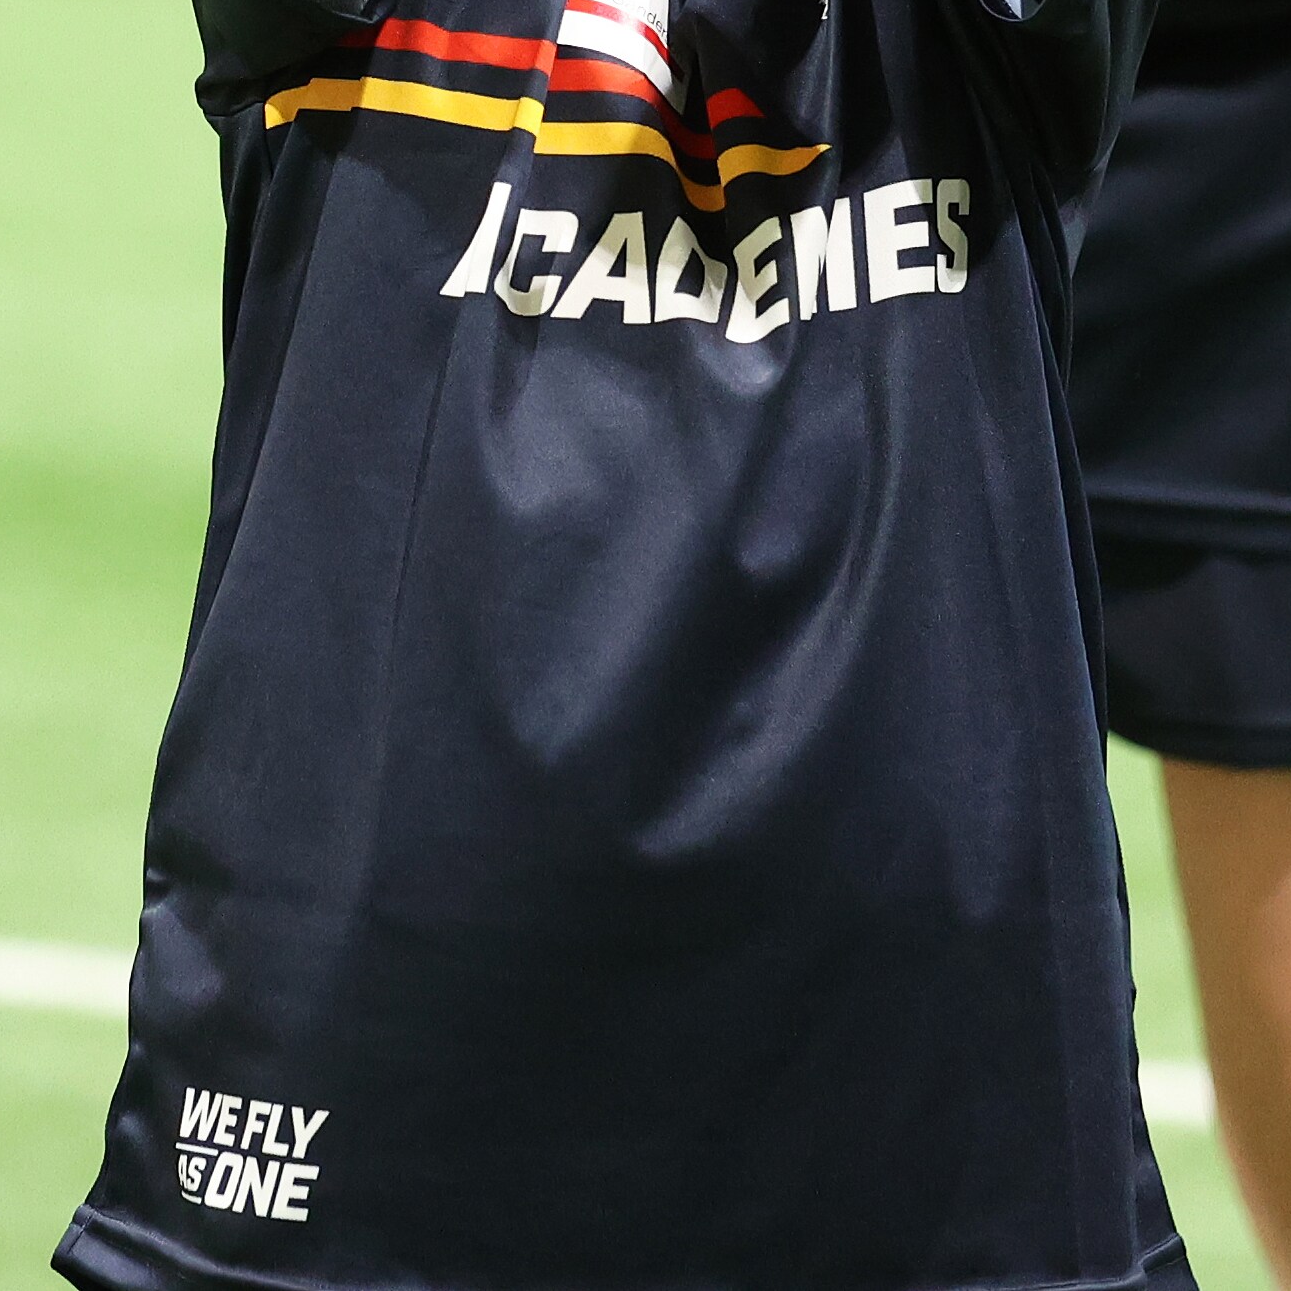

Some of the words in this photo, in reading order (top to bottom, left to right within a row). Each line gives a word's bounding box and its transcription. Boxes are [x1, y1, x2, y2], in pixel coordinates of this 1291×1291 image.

[179, 1087, 243, 1147] WE
[240, 1100, 330, 1159] FLY
[178, 1154, 207, 1192] AS
[204, 1151, 320, 1222] ONE
